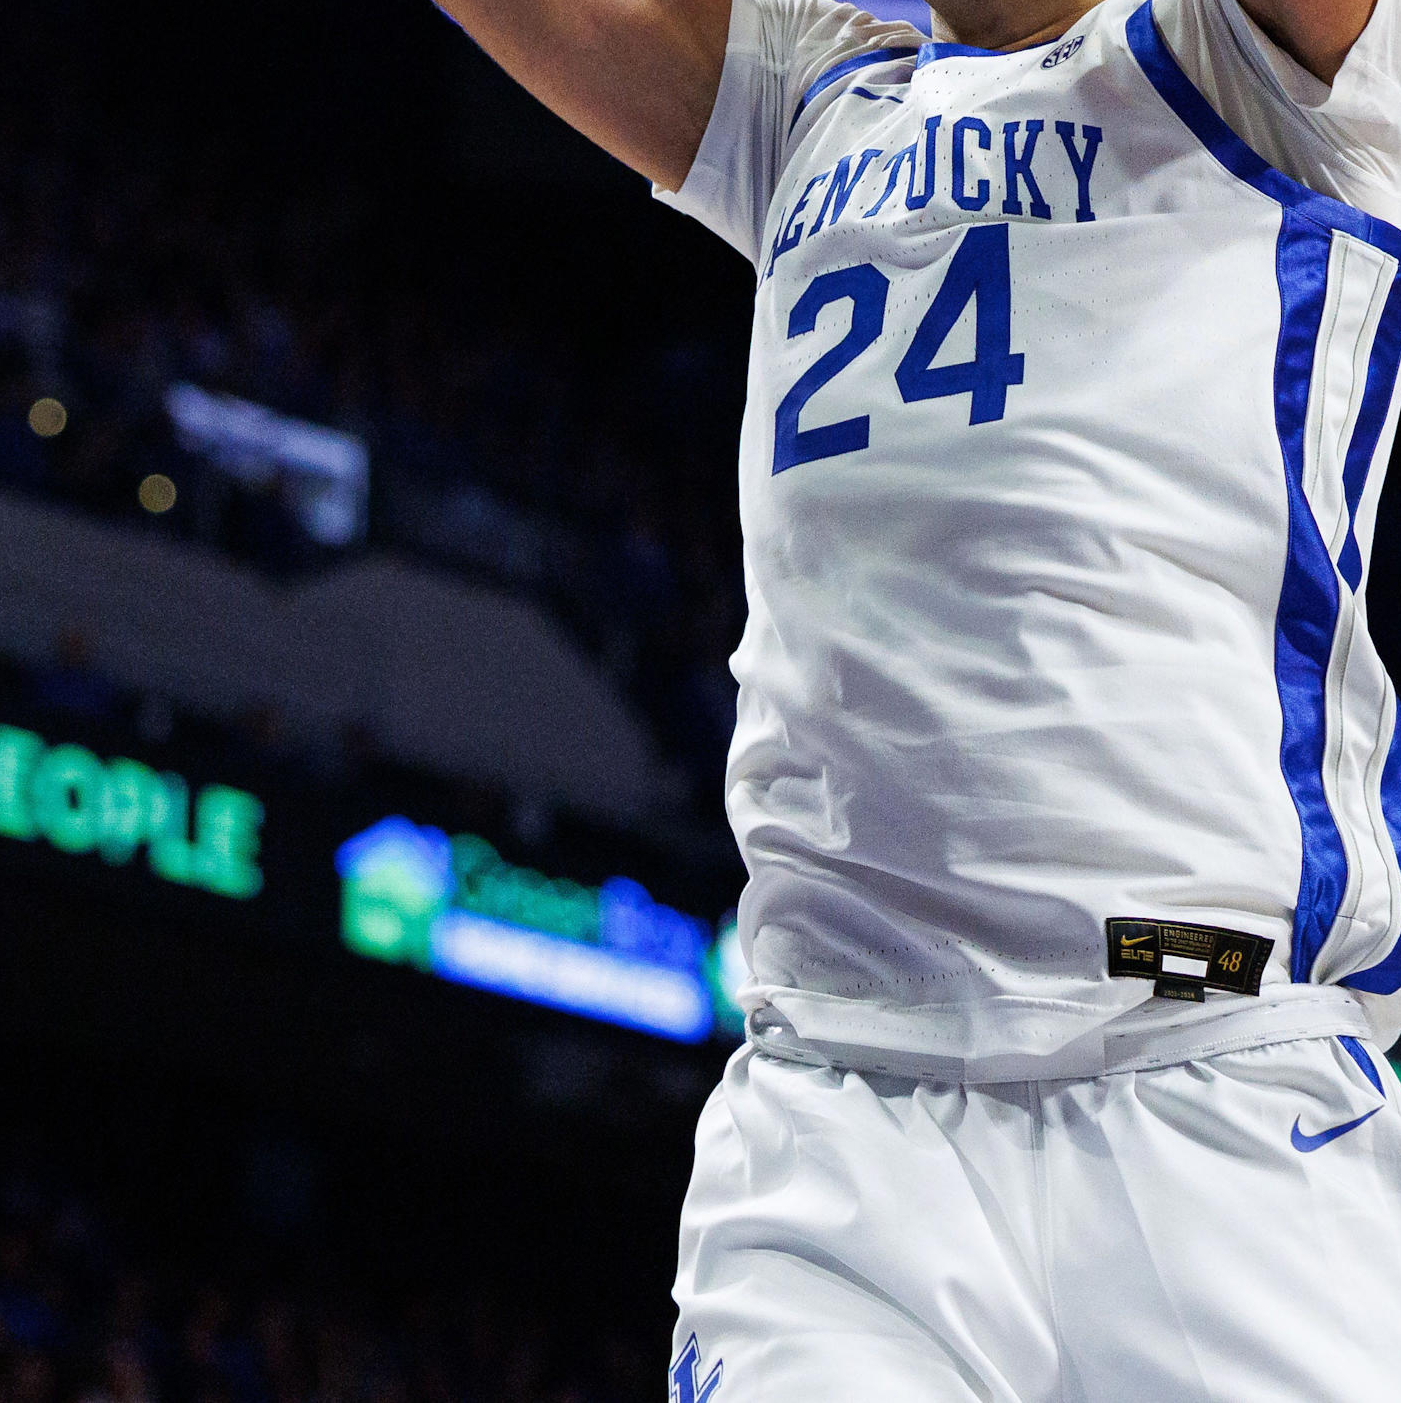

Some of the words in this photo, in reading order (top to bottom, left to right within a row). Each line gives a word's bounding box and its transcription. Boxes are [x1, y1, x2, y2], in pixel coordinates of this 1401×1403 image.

[1041, 35, 1085, 69] SEC
[771, 222, 1025, 476] 24
[1163, 928, 1214, 944] ENGINEERED
[1218, 949, 1243, 973] 48
